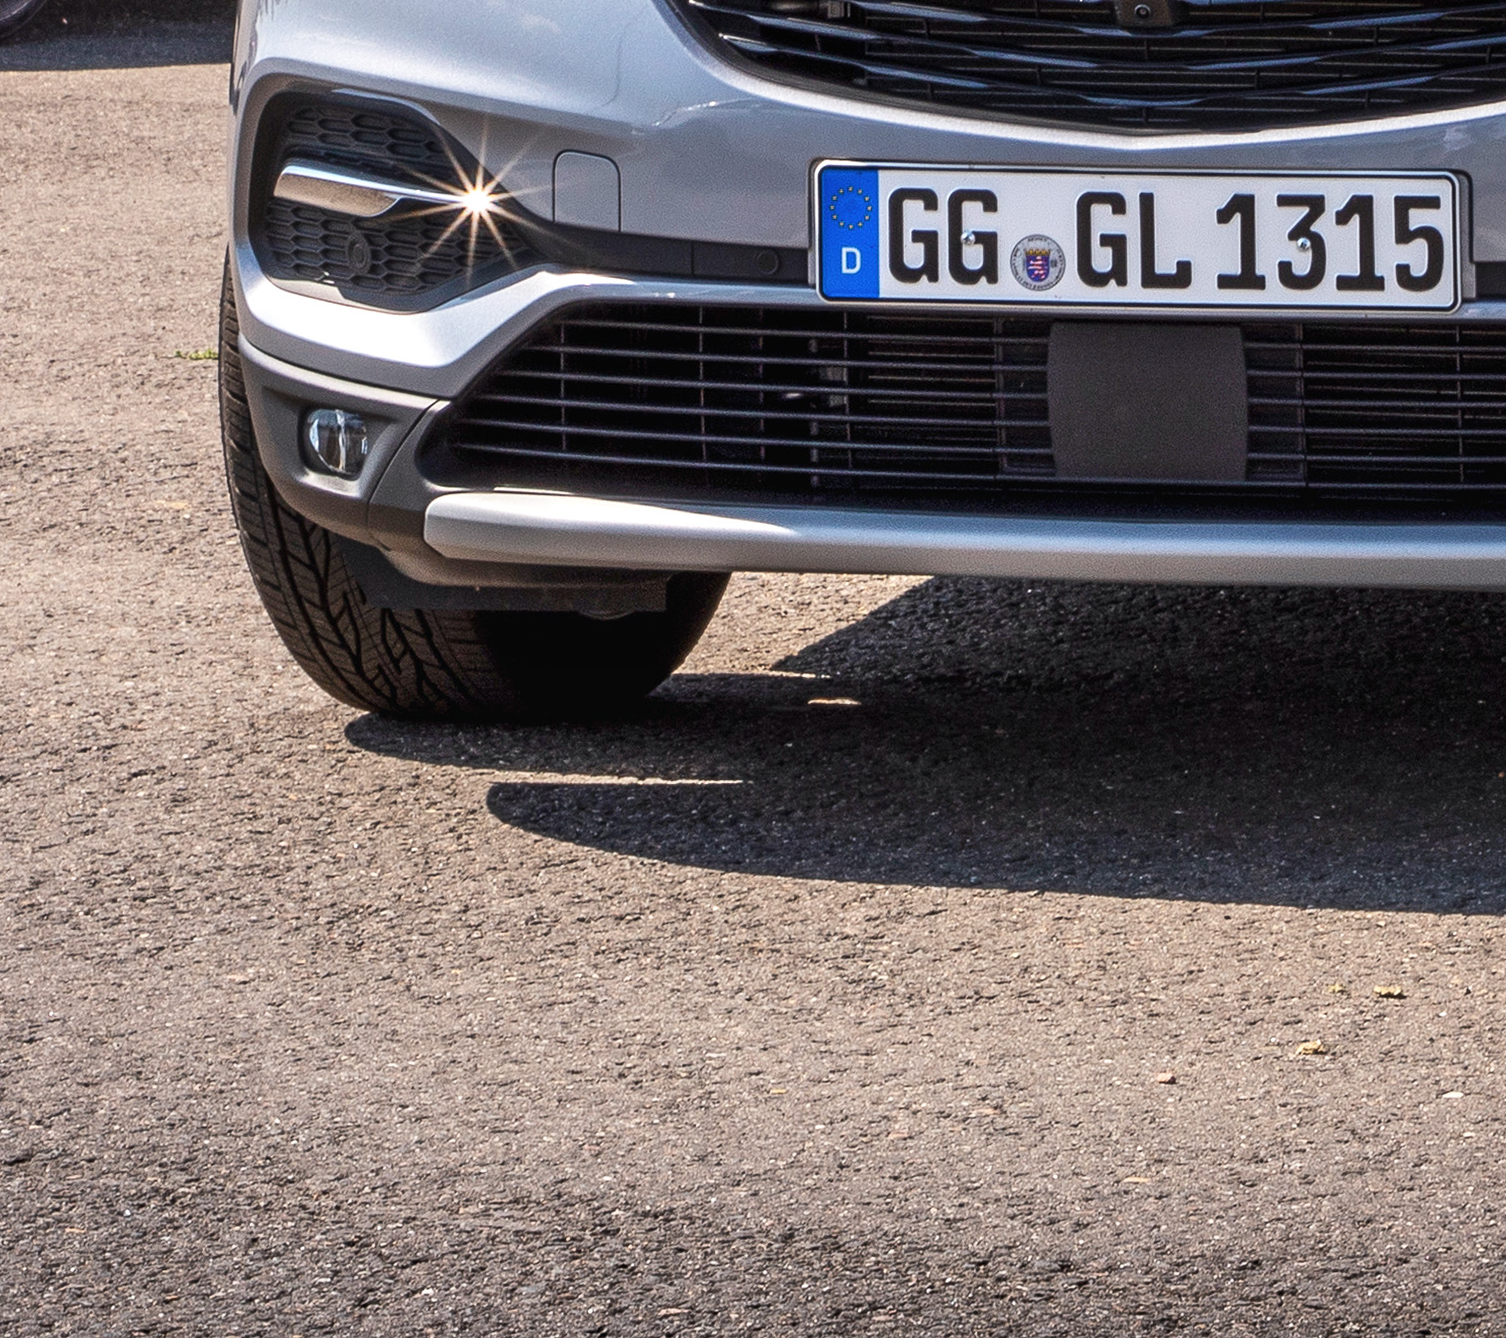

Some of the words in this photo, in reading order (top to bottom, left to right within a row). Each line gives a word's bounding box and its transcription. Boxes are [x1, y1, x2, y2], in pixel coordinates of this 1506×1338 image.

[841, 246, 861, 273] D
[888, 187, 999, 285] GG
[1076, 190, 1192, 291] GL
[1216, 192, 1444, 293] 1315
